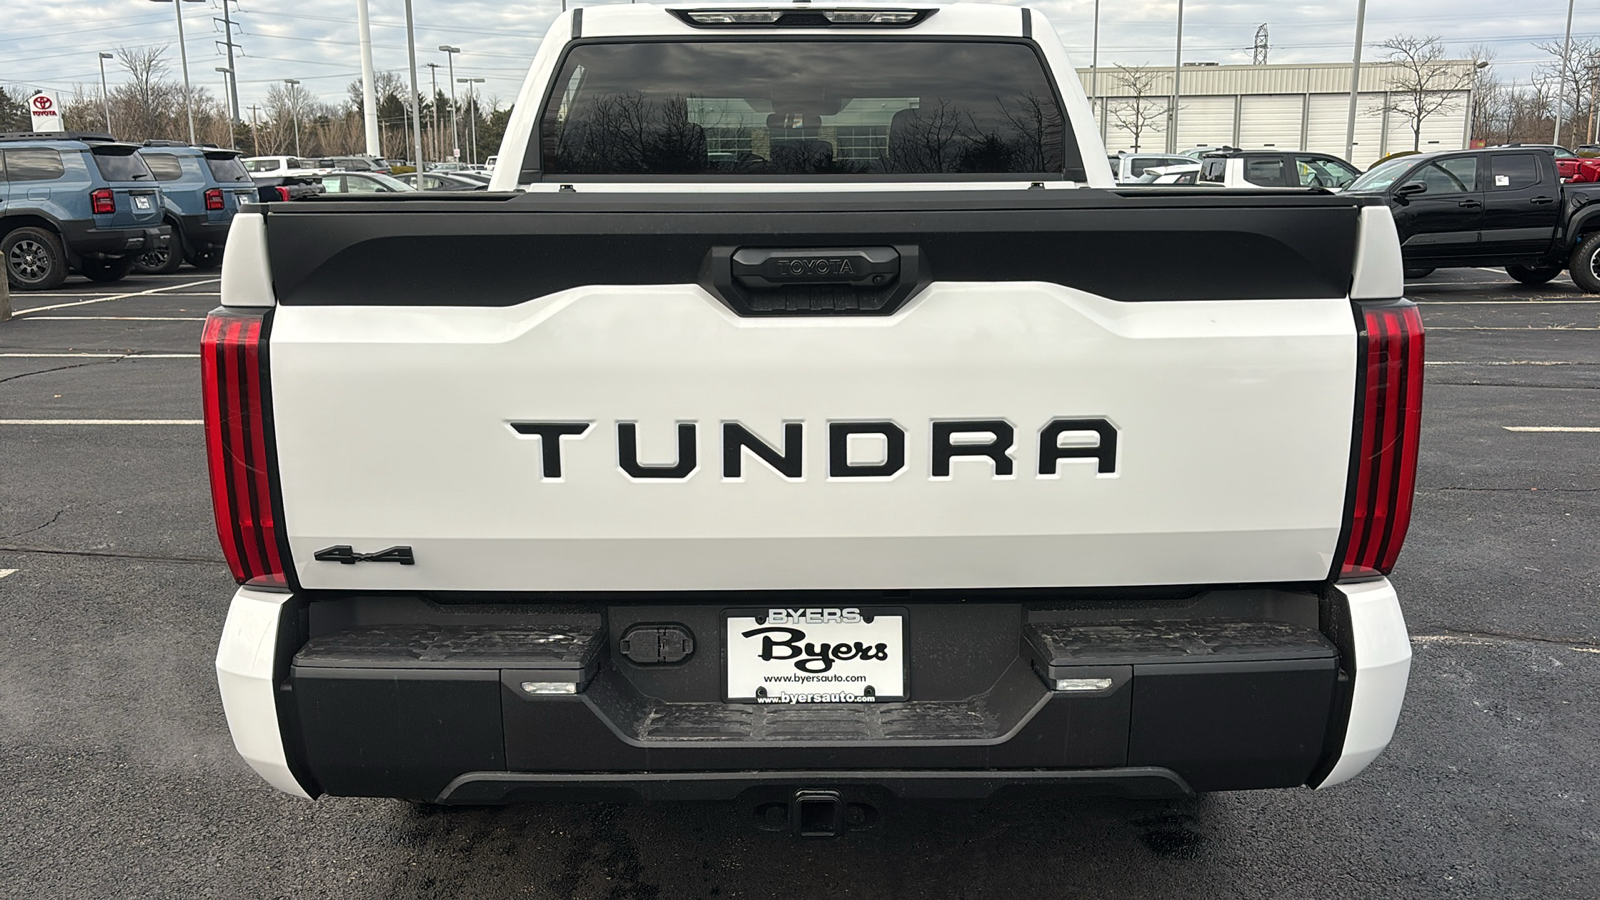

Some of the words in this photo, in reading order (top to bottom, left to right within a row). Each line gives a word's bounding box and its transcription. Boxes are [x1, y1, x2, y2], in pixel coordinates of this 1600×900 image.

[777, 259, 855, 275] TOYOTA
[508, 419, 1117, 479] TUNDRA
[768, 608, 861, 624] BYERS
[741, 626, 888, 673] Byers
[764, 673, 866, 684] www.byersauto.com
[757, 691, 876, 704] www.byersauto.com
